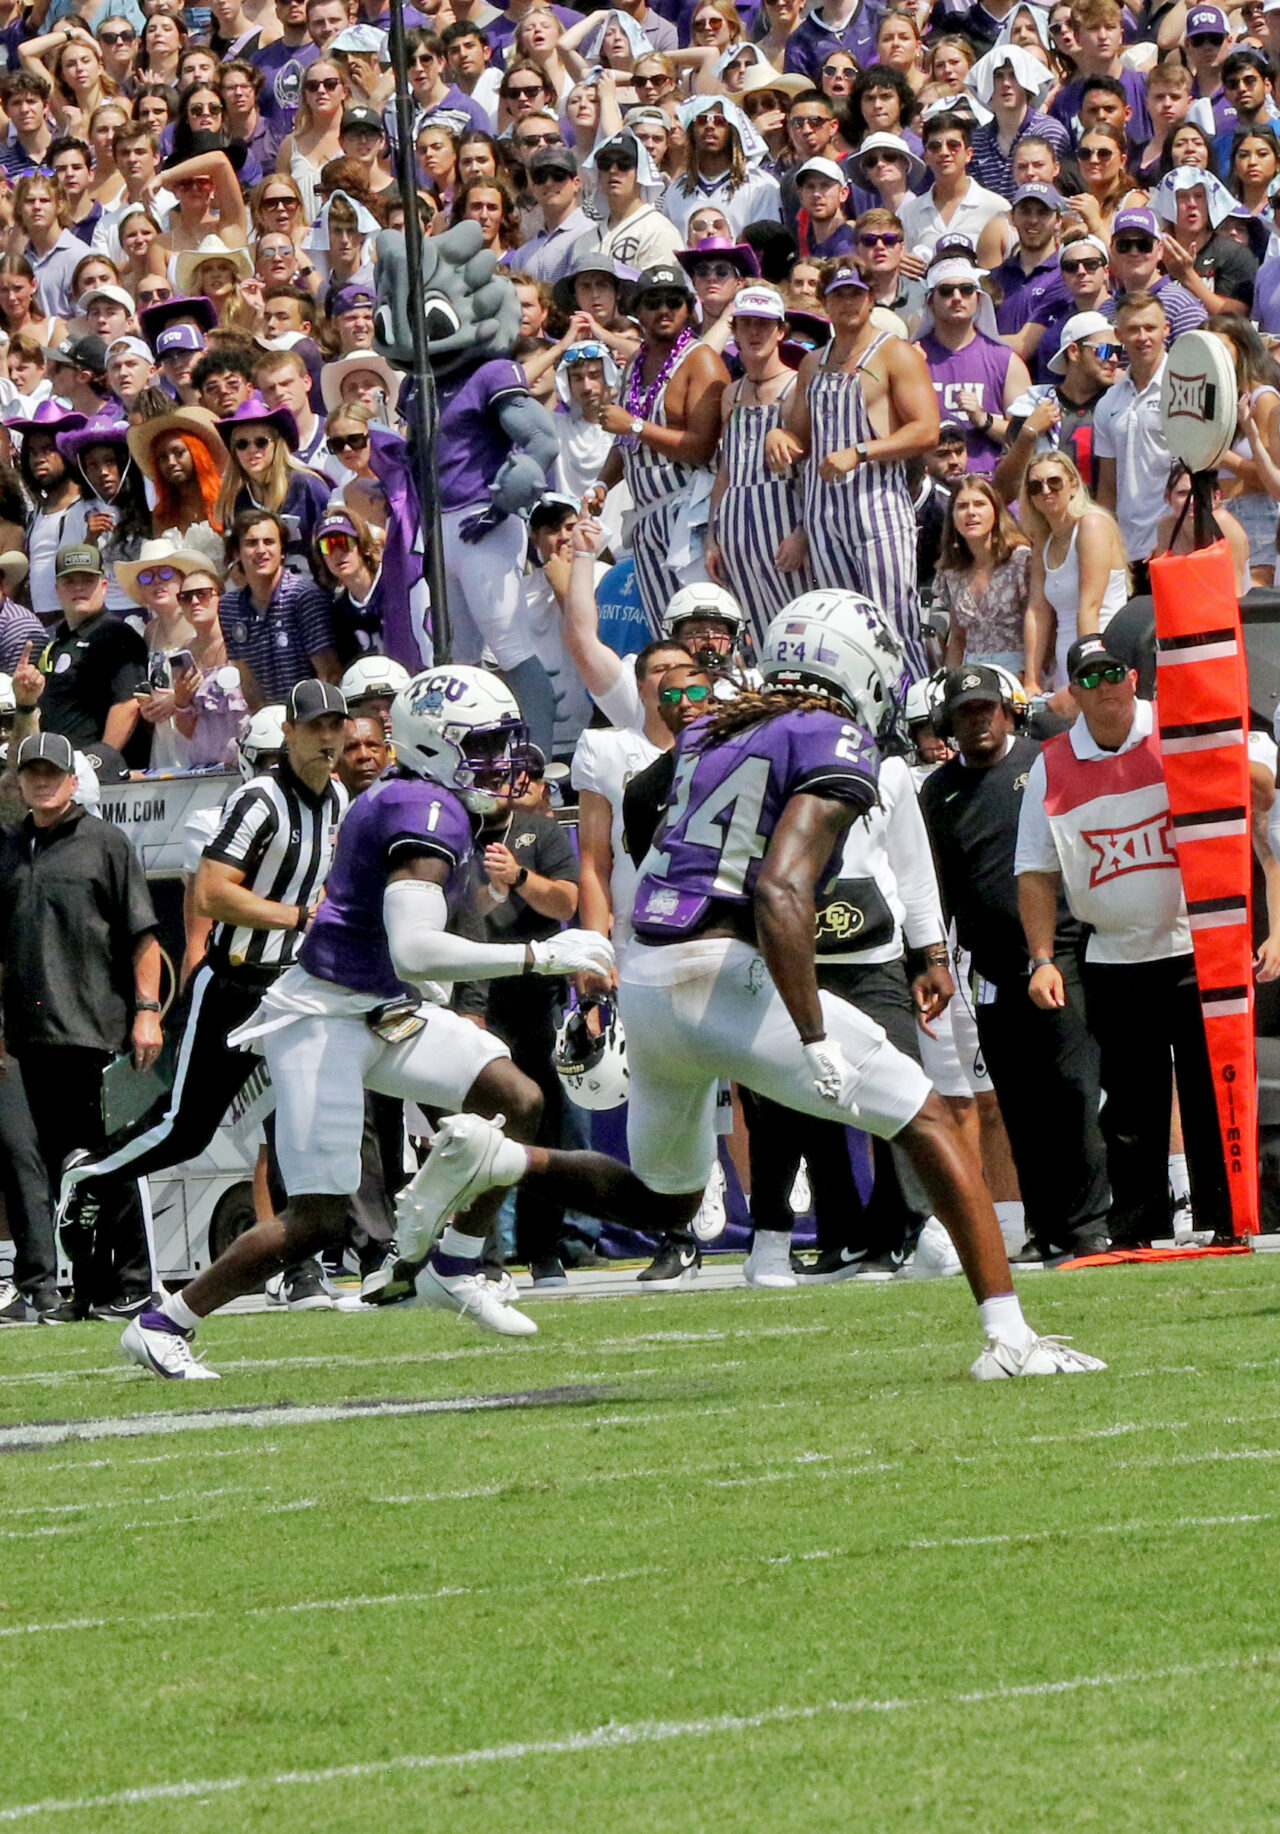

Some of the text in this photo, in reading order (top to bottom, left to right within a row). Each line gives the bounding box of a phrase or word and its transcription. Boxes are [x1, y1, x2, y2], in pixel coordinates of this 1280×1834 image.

[1192, 12, 1217, 26] TCU
[1025, 183, 1048, 193] TCU
[942, 235, 969, 247] TCU
[777, 641, 806, 663] 24
[404, 675, 469, 702] TCU
[98, 799, 165, 825] MM.COM
[426, 800, 442, 833] 1
[292, 829, 300, 844] S
[1223, 1065, 1242, 1173] Gilman
